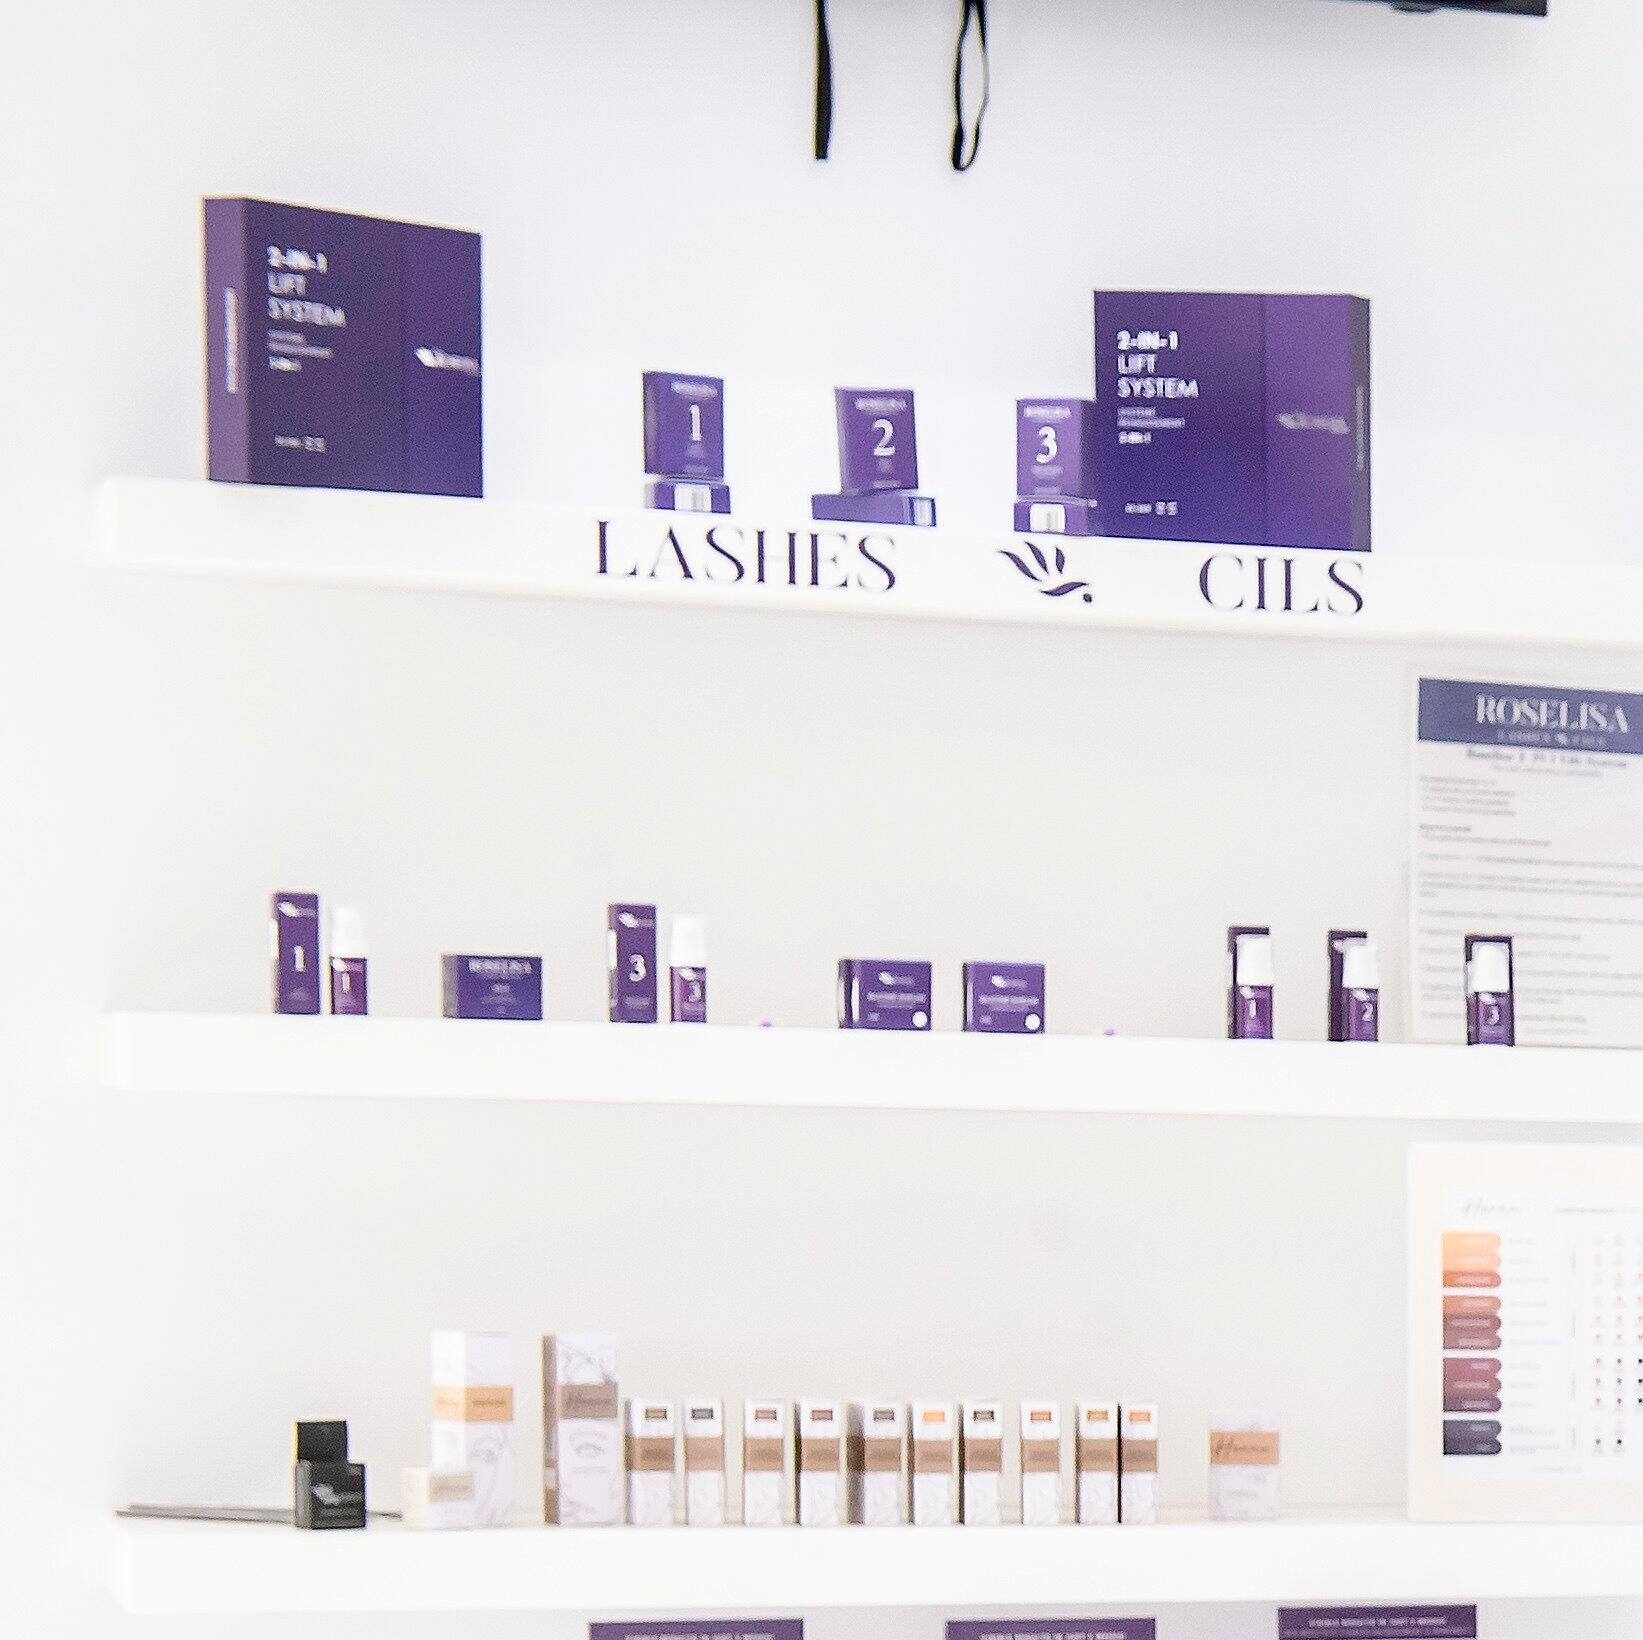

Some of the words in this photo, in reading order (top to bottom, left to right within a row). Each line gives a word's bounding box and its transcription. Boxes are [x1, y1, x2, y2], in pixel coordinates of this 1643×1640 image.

[1116, 353, 1157, 374] LIFT
[1116, 376, 1199, 399] SYSTEM
[688, 404, 703, 442] 1
[872, 418, 896, 457] 2
[1035, 425, 1059, 464] 3
[596, 519, 897, 592] LASHES
[1199, 553, 1364, 616] CILS
[1475, 693, 1630, 735] ROSELISA
